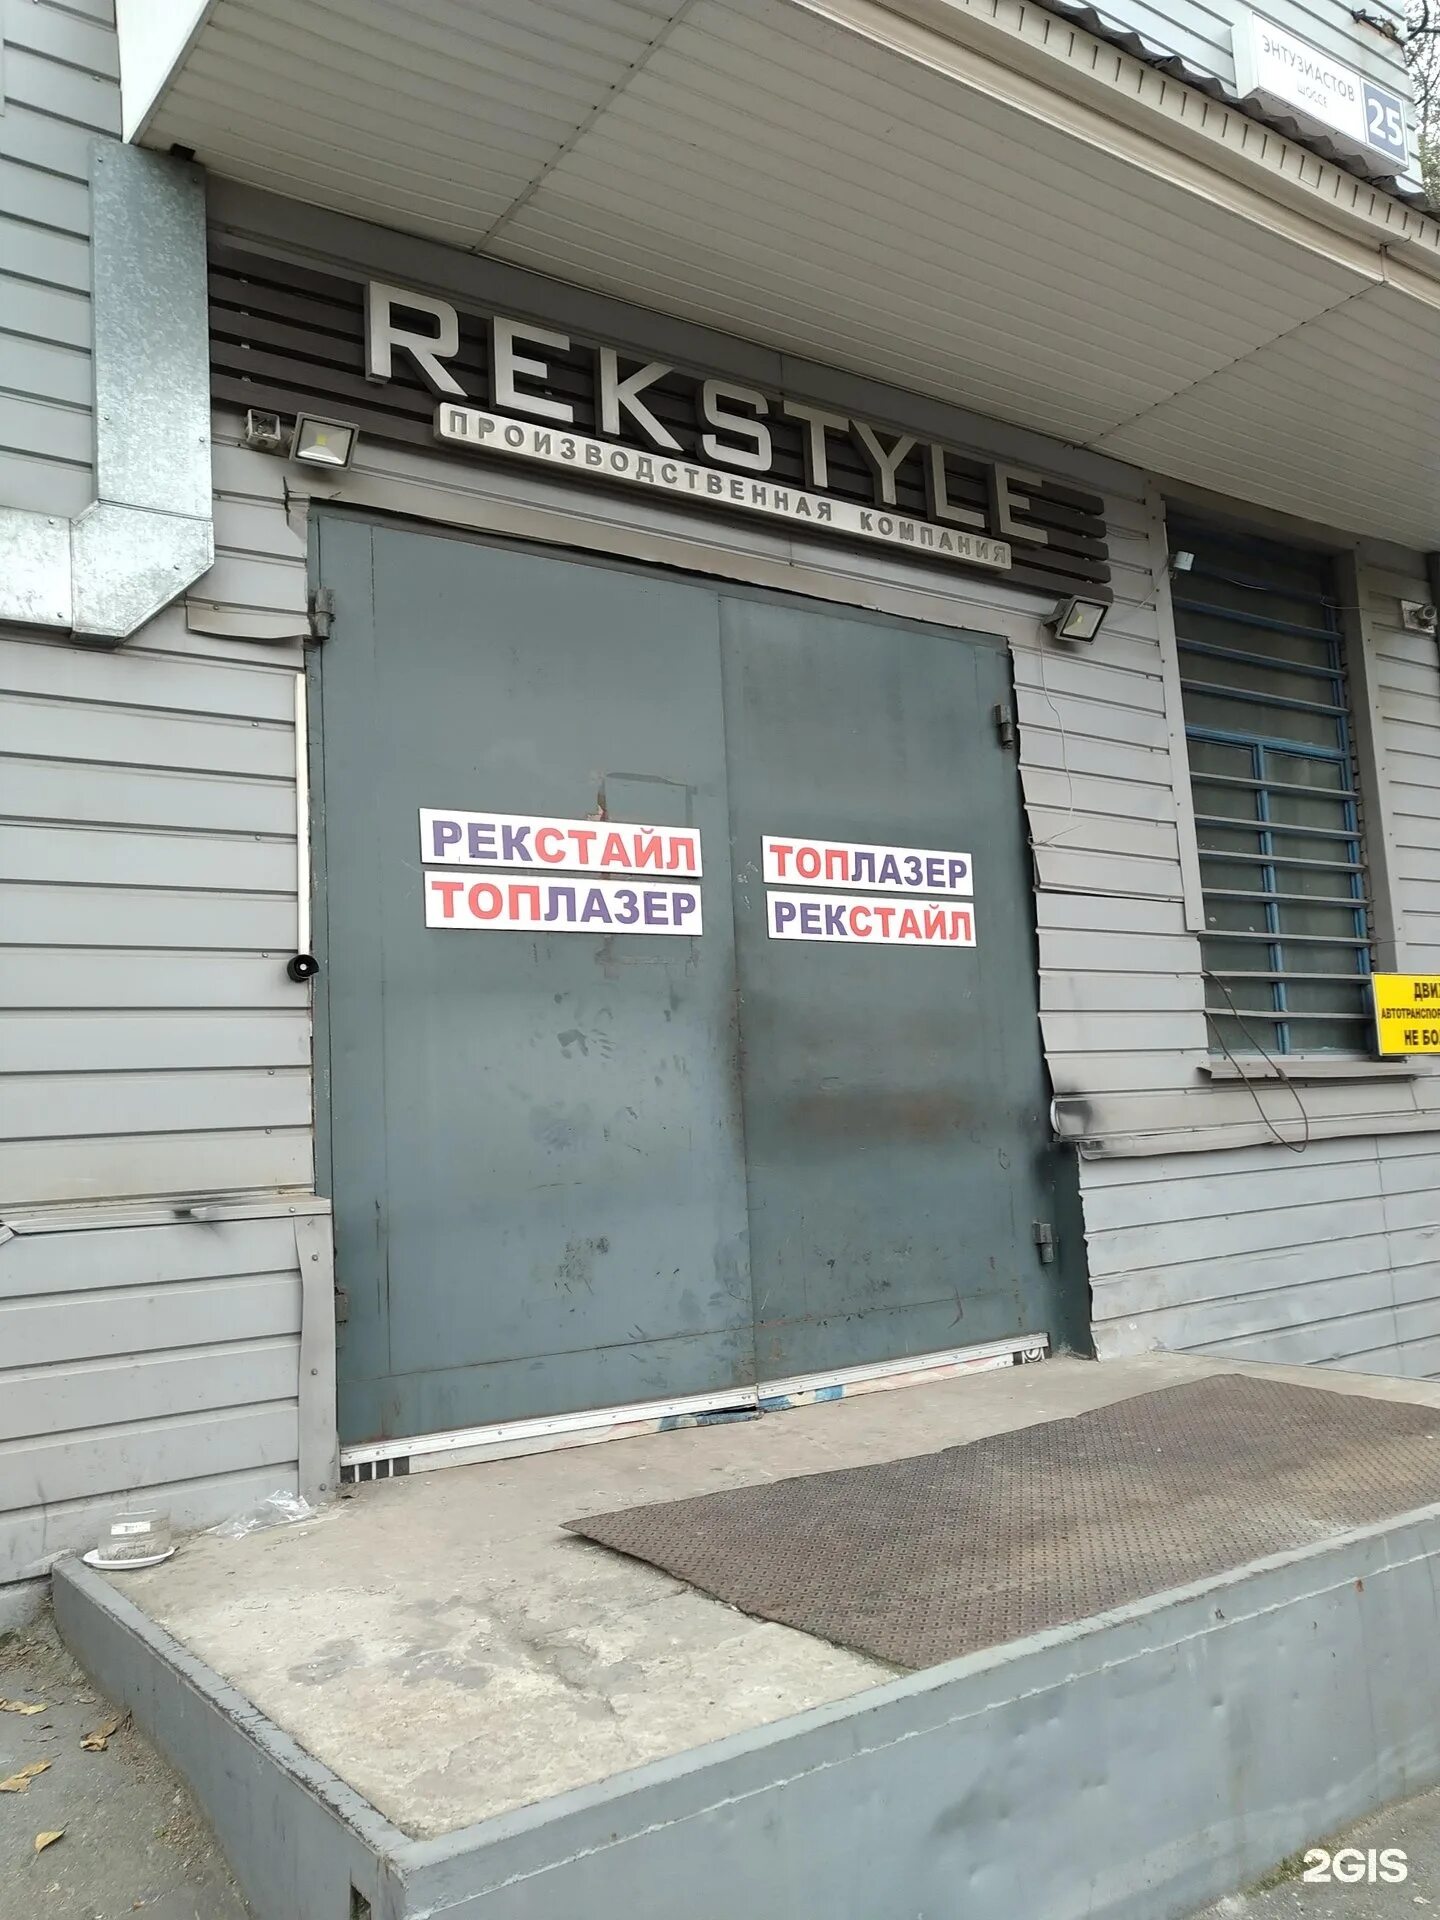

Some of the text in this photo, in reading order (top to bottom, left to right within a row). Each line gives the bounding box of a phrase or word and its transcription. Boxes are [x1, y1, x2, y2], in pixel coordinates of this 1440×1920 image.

[1262, 35, 1355, 102] ЭНТУЗИАСТОВ
[1367, 98, 1403, 146] 25
[366, 280, 1049, 545] REKSTYLE
[450, 410, 1007, 564] ПРОИЗВОДСТВЕННАЯ КОМПАНИЯ
[432, 820, 697, 871] РЕКСТАЙЛ
[770, 844, 967, 889] ТОПЛАЗЕР
[431, 881, 696, 926] ТОПЛАЗЕР
[775, 901, 972, 941] РЕКСТАЙЛ
[1413, 982, 1440, 1001] ДВИ
[1404, 1029, 1440, 1045] НЕ БО
